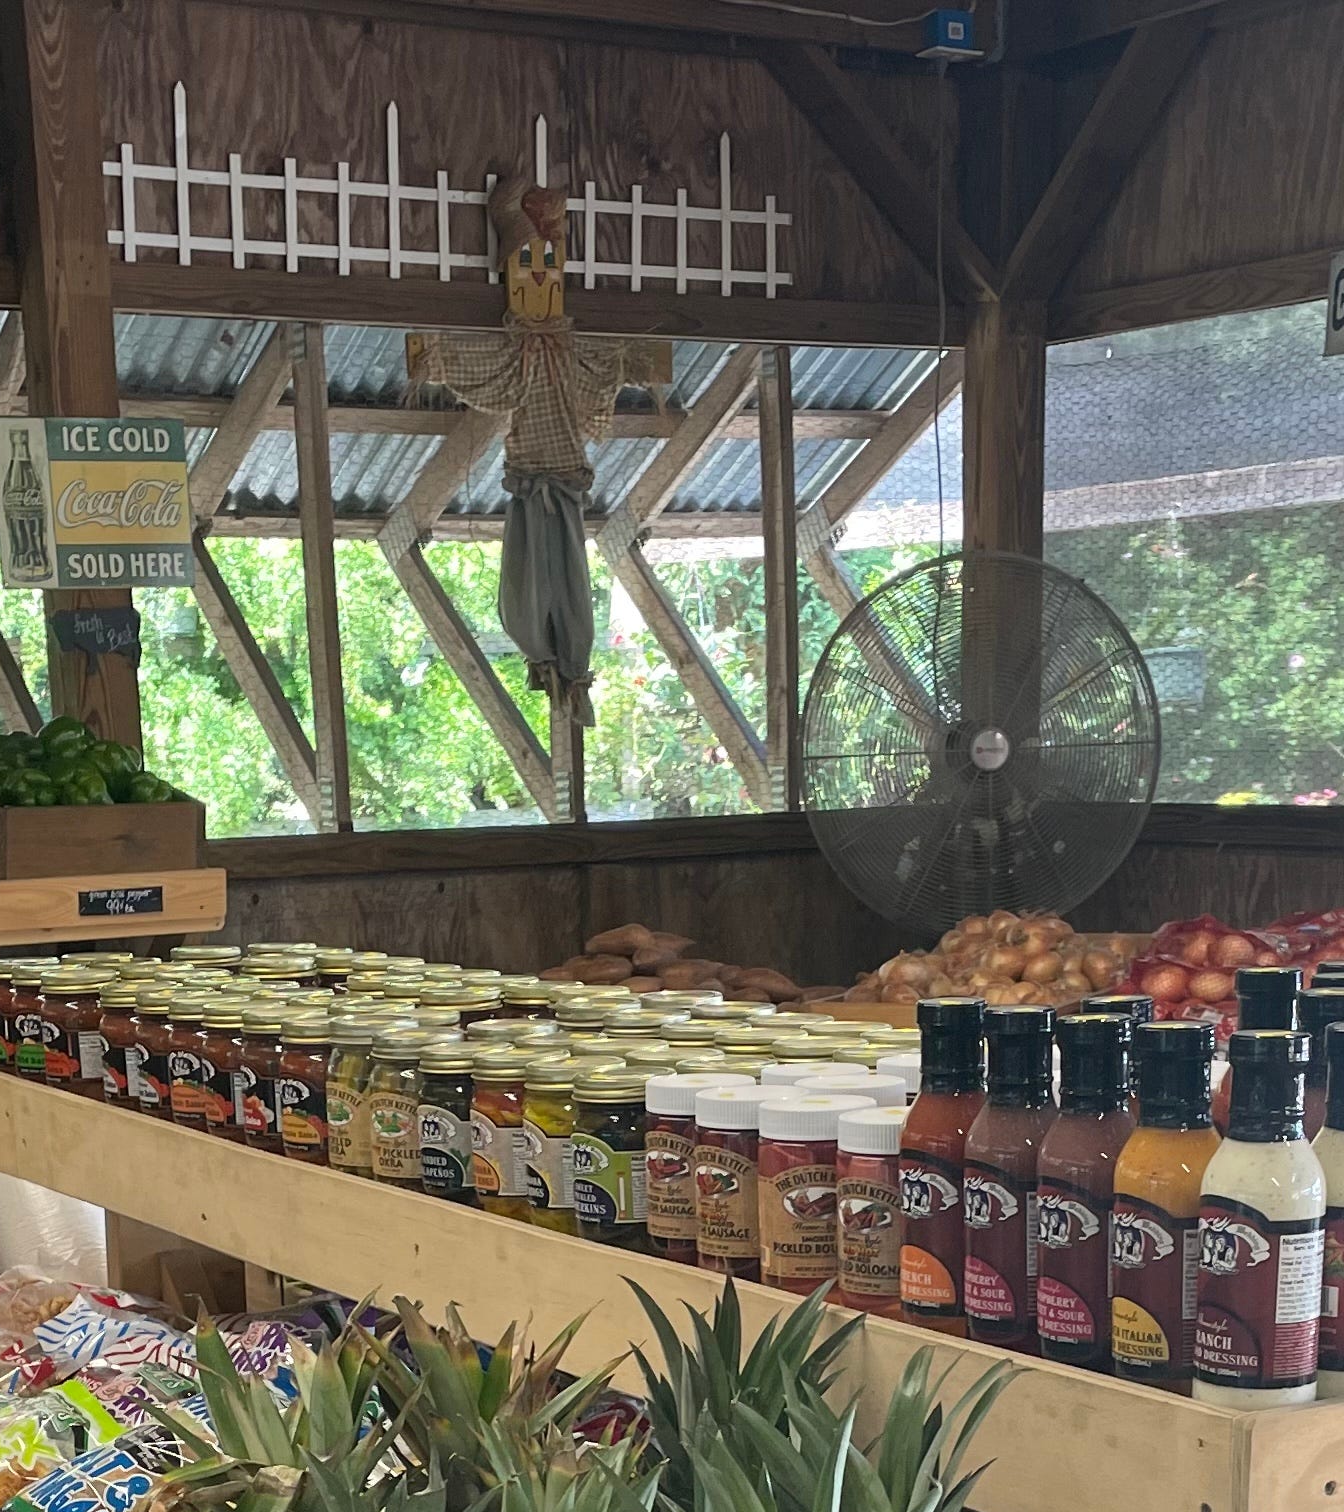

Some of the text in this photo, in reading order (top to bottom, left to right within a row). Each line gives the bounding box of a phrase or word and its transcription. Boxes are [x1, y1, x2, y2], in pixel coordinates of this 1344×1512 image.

[62, 425, 170, 452] ICE COLD
[67, 552, 186, 579] SOLD HERE
[775, 1170, 829, 1193] THE DUTCH
[659, 1204, 695, 1216] SAUSAG
[980, 1288, 1006, 1300] SOUR
[1057, 1310, 1086, 1322] SOUR
[1122, 1331, 1162, 1344] ITALIAN
[1203, 1349, 1258, 1368] DRESSING
